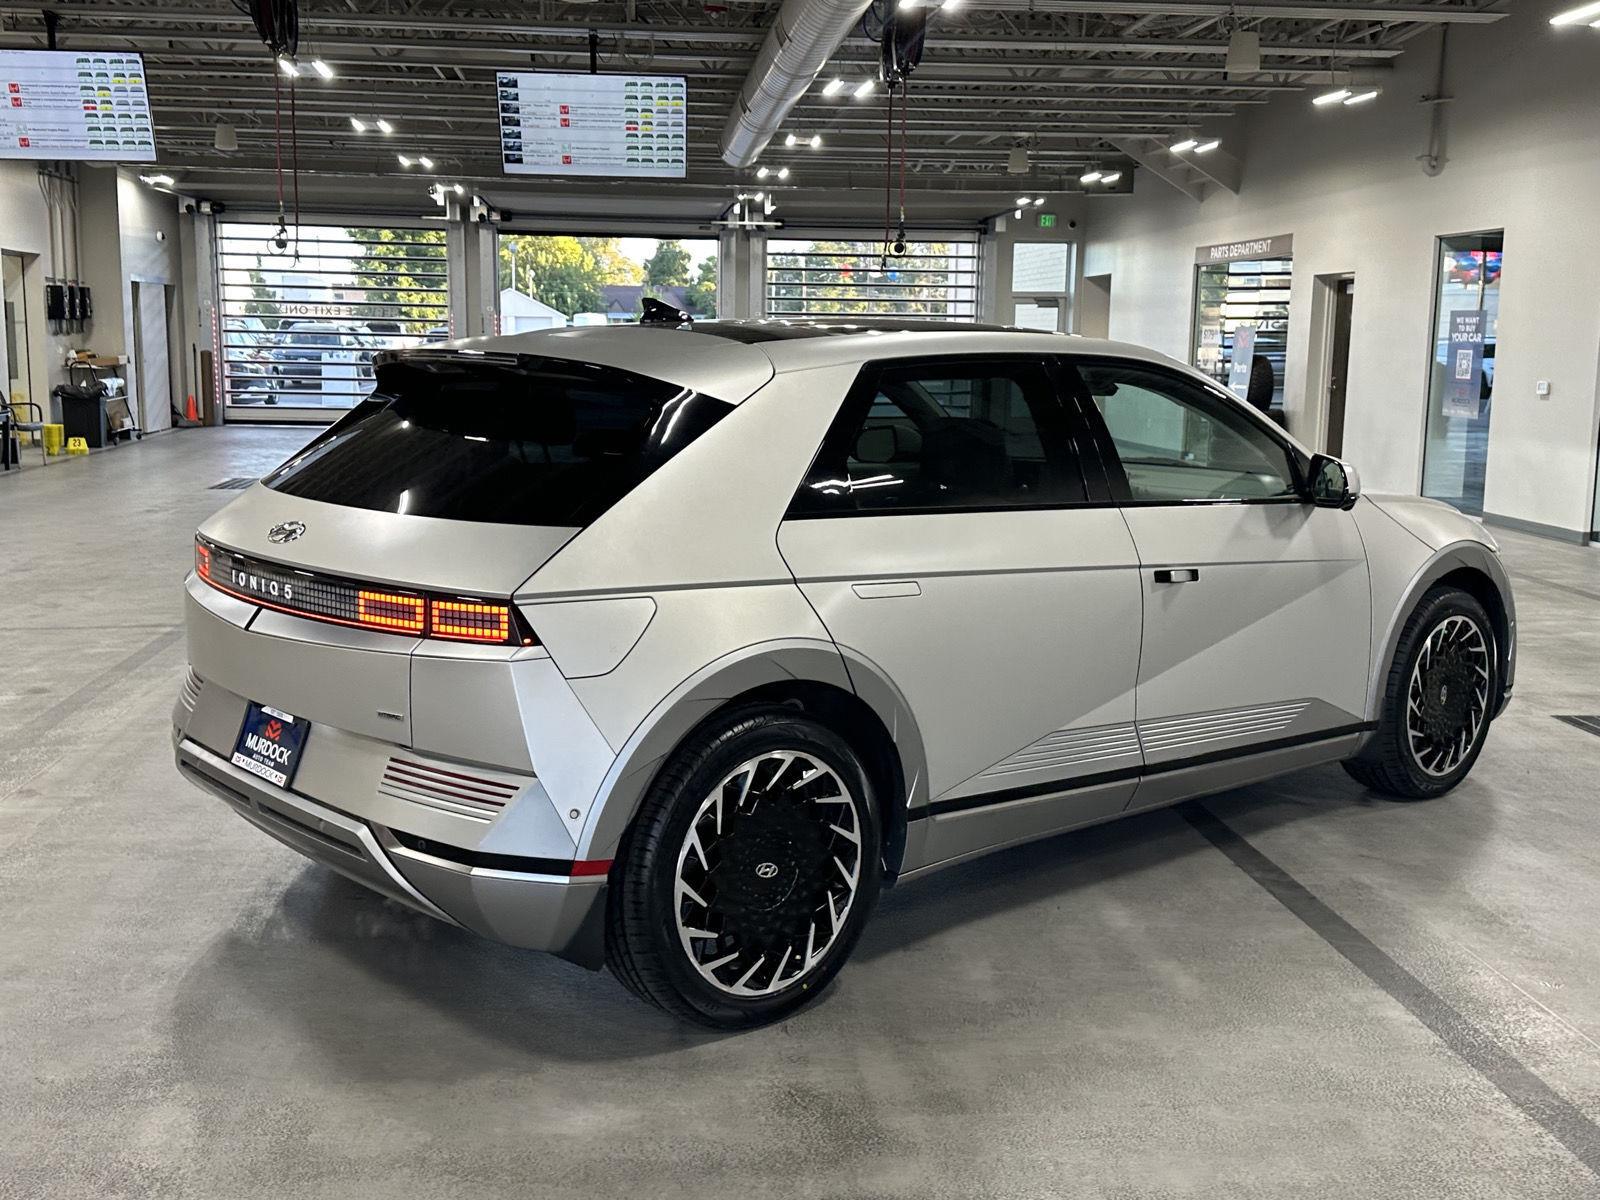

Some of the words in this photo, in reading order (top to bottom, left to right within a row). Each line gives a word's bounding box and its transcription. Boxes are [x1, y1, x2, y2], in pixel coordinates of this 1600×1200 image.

[1040, 214, 1056, 227] EXIT
[1210, 246, 1228, 259] PARTS
[1229, 240, 1271, 257] DEPARTMENT
[1452, 332, 1468, 342] YOUR
[1469, 333, 1482, 342] CAR
[73, 438, 81, 447] 23
[232, 569, 279, 596] IONIQ
[284, 584, 293, 599] 5
[245, 732, 292, 765] MURDOCK
